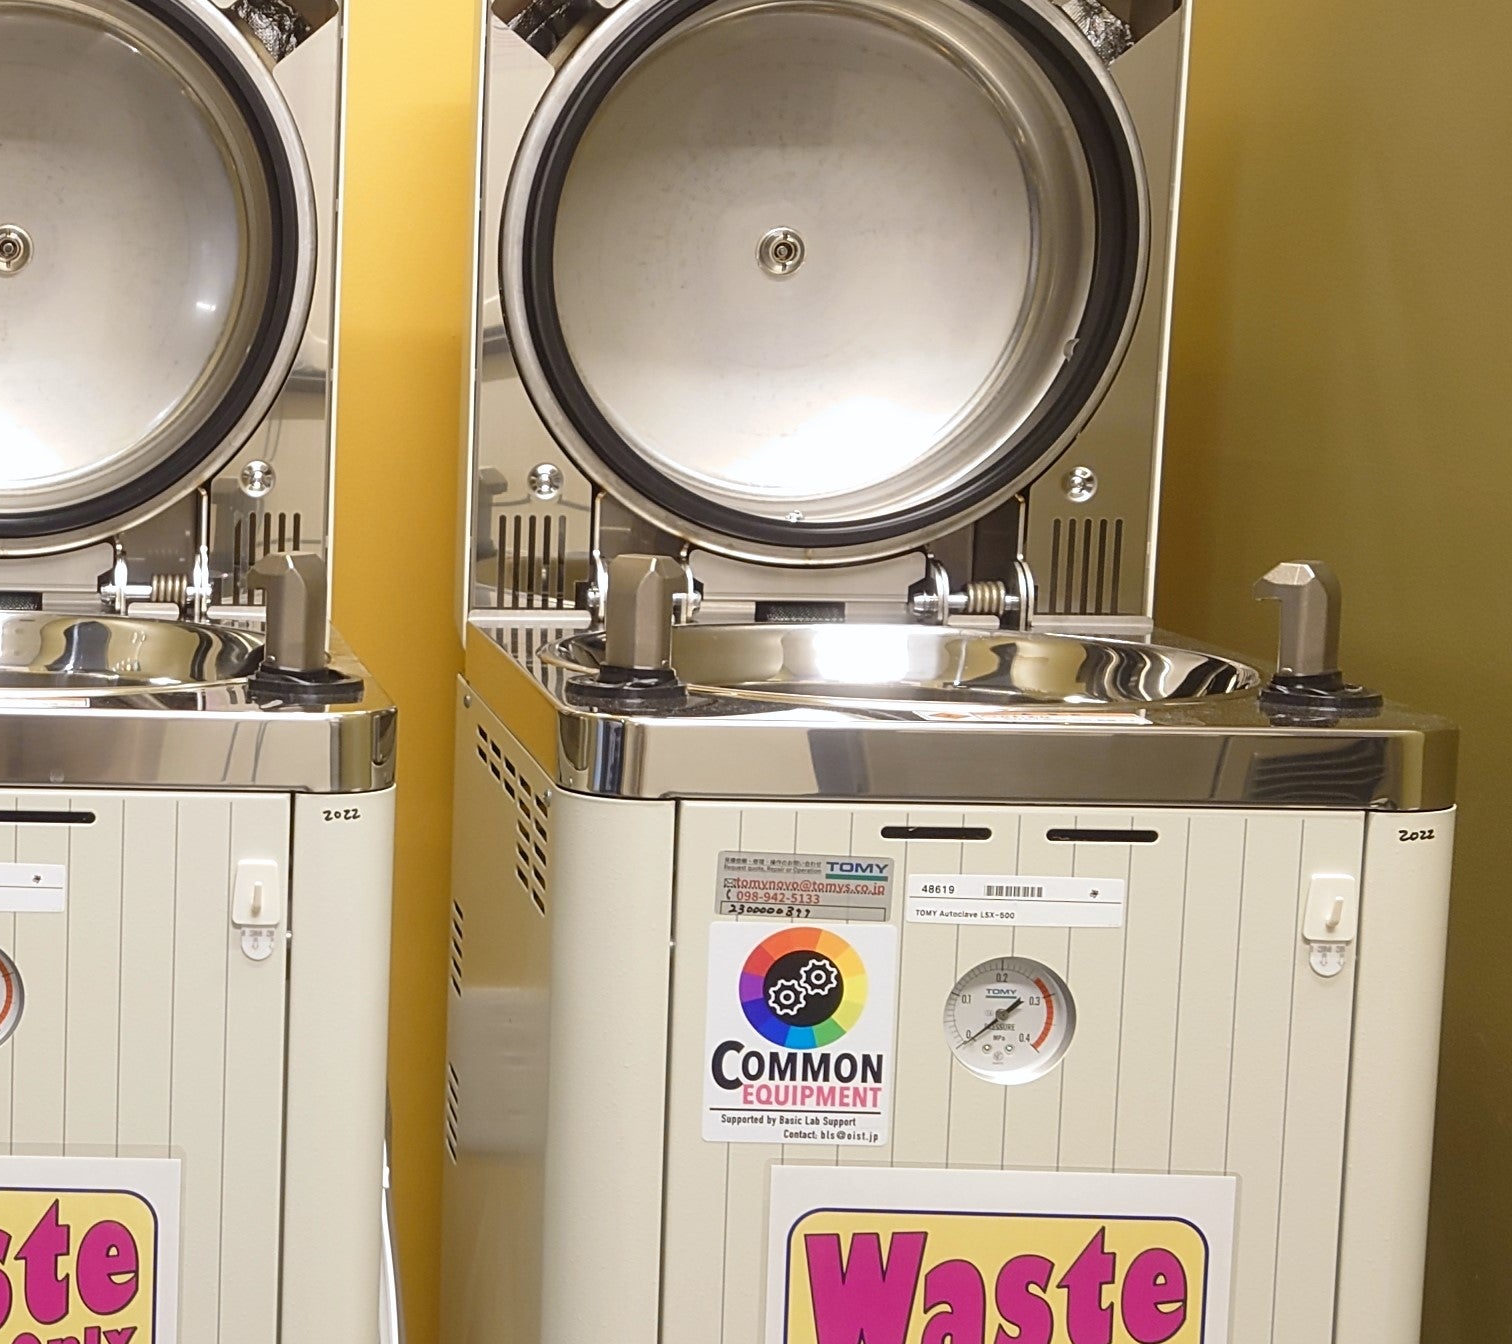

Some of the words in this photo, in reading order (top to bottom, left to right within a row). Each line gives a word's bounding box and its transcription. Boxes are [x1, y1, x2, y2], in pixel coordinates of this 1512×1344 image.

[323, 808, 361, 821] 2022
[1399, 829, 1435, 841] 2022
[826, 861, 888, 874] TOMY
[922, 885, 955, 894] 48619
[737, 891, 820, 904] 098-942-5133
[996, 973, 1008, 982] 0.2
[962, 995, 971, 1003] 0.1
[1029, 997, 1040, 1005] 0.3
[1019, 1033, 1030, 1042] 0.4
[712, 1040, 883, 1090] COMMON
[742, 1085, 882, 1108] EQUIPMENT
